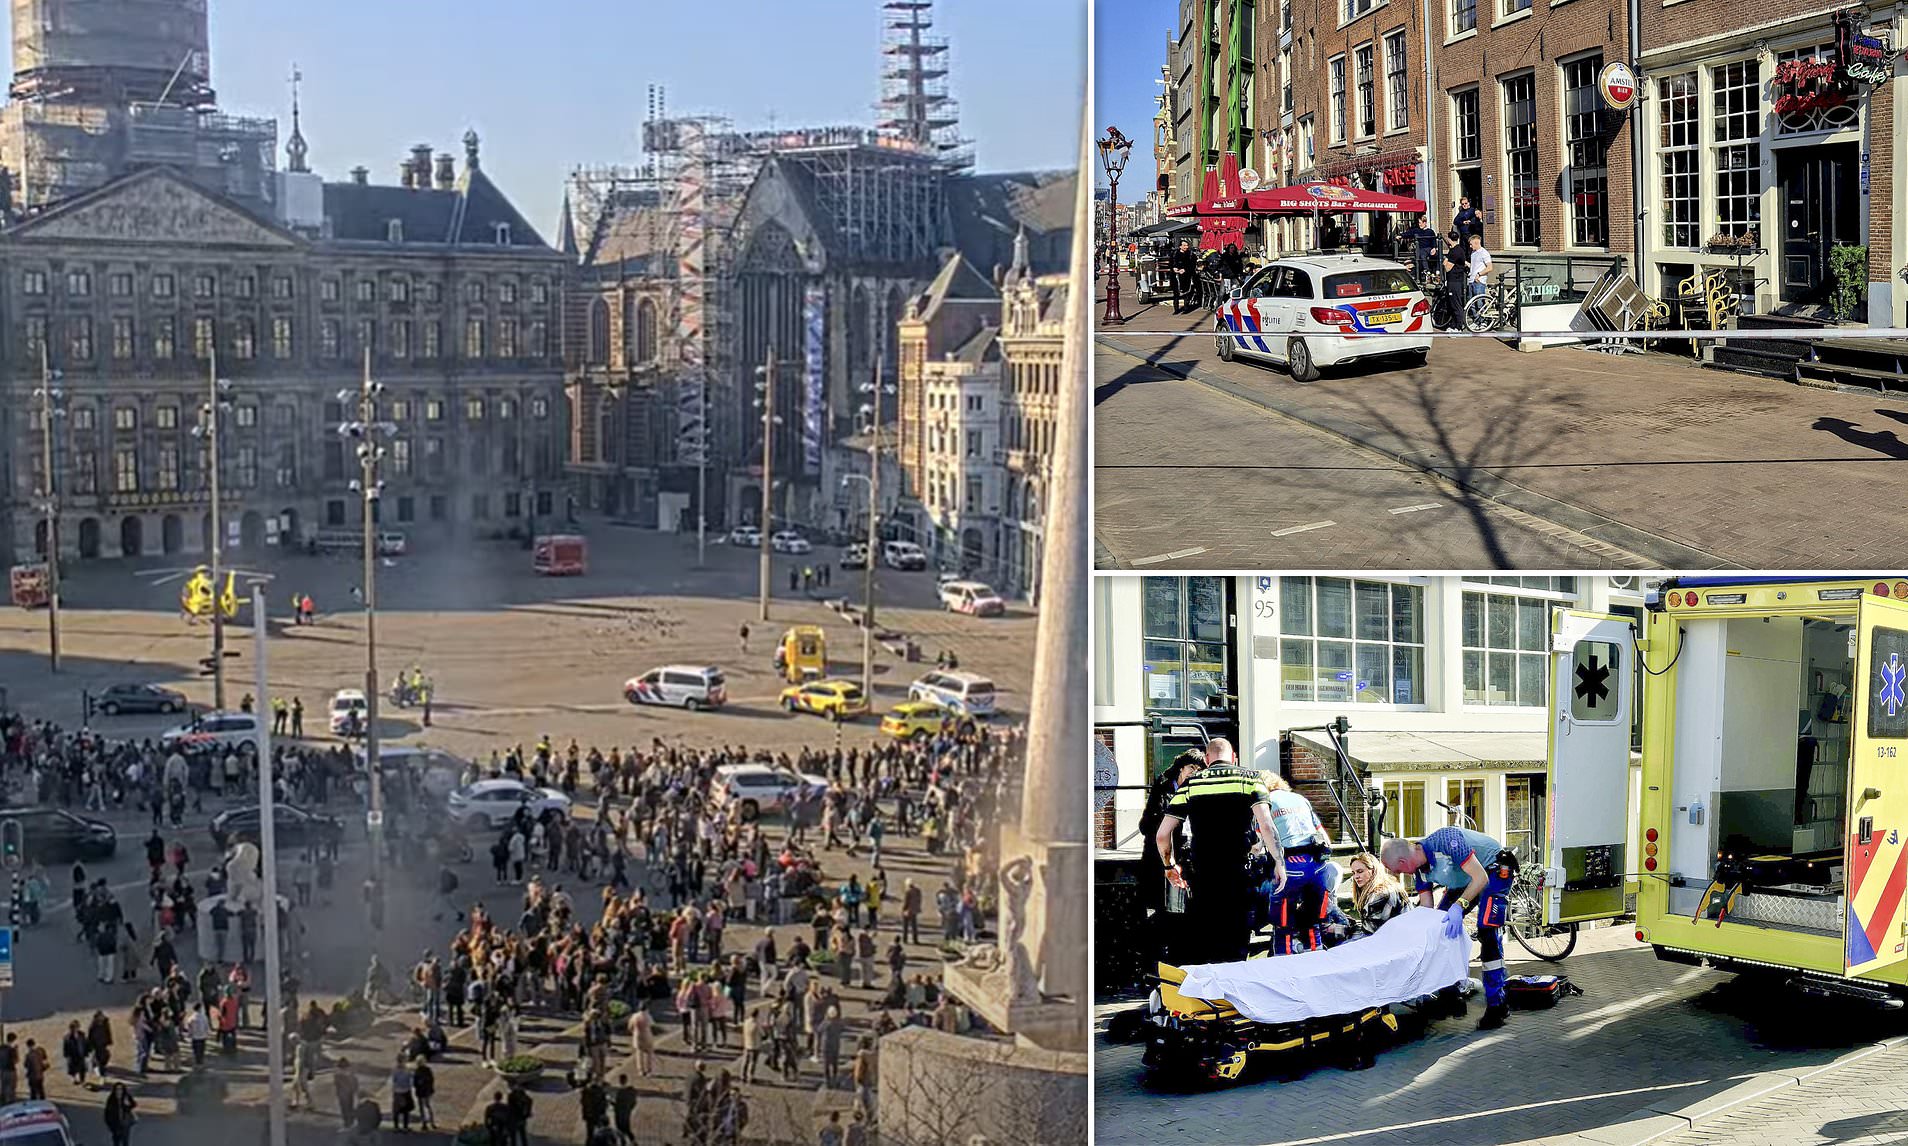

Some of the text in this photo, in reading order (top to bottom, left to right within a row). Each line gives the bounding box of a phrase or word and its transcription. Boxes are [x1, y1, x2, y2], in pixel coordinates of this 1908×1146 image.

[1847, 63, 1887, 84] Cafe
[1609, 77, 1633, 87] AMSTEL
[1331, 200, 1347, 208] Bar
[1353, 201, 1398, 209] Restaurant
[1255, 600, 1275, 618] 95
[1877, 747, 1897, 758] 13-162
